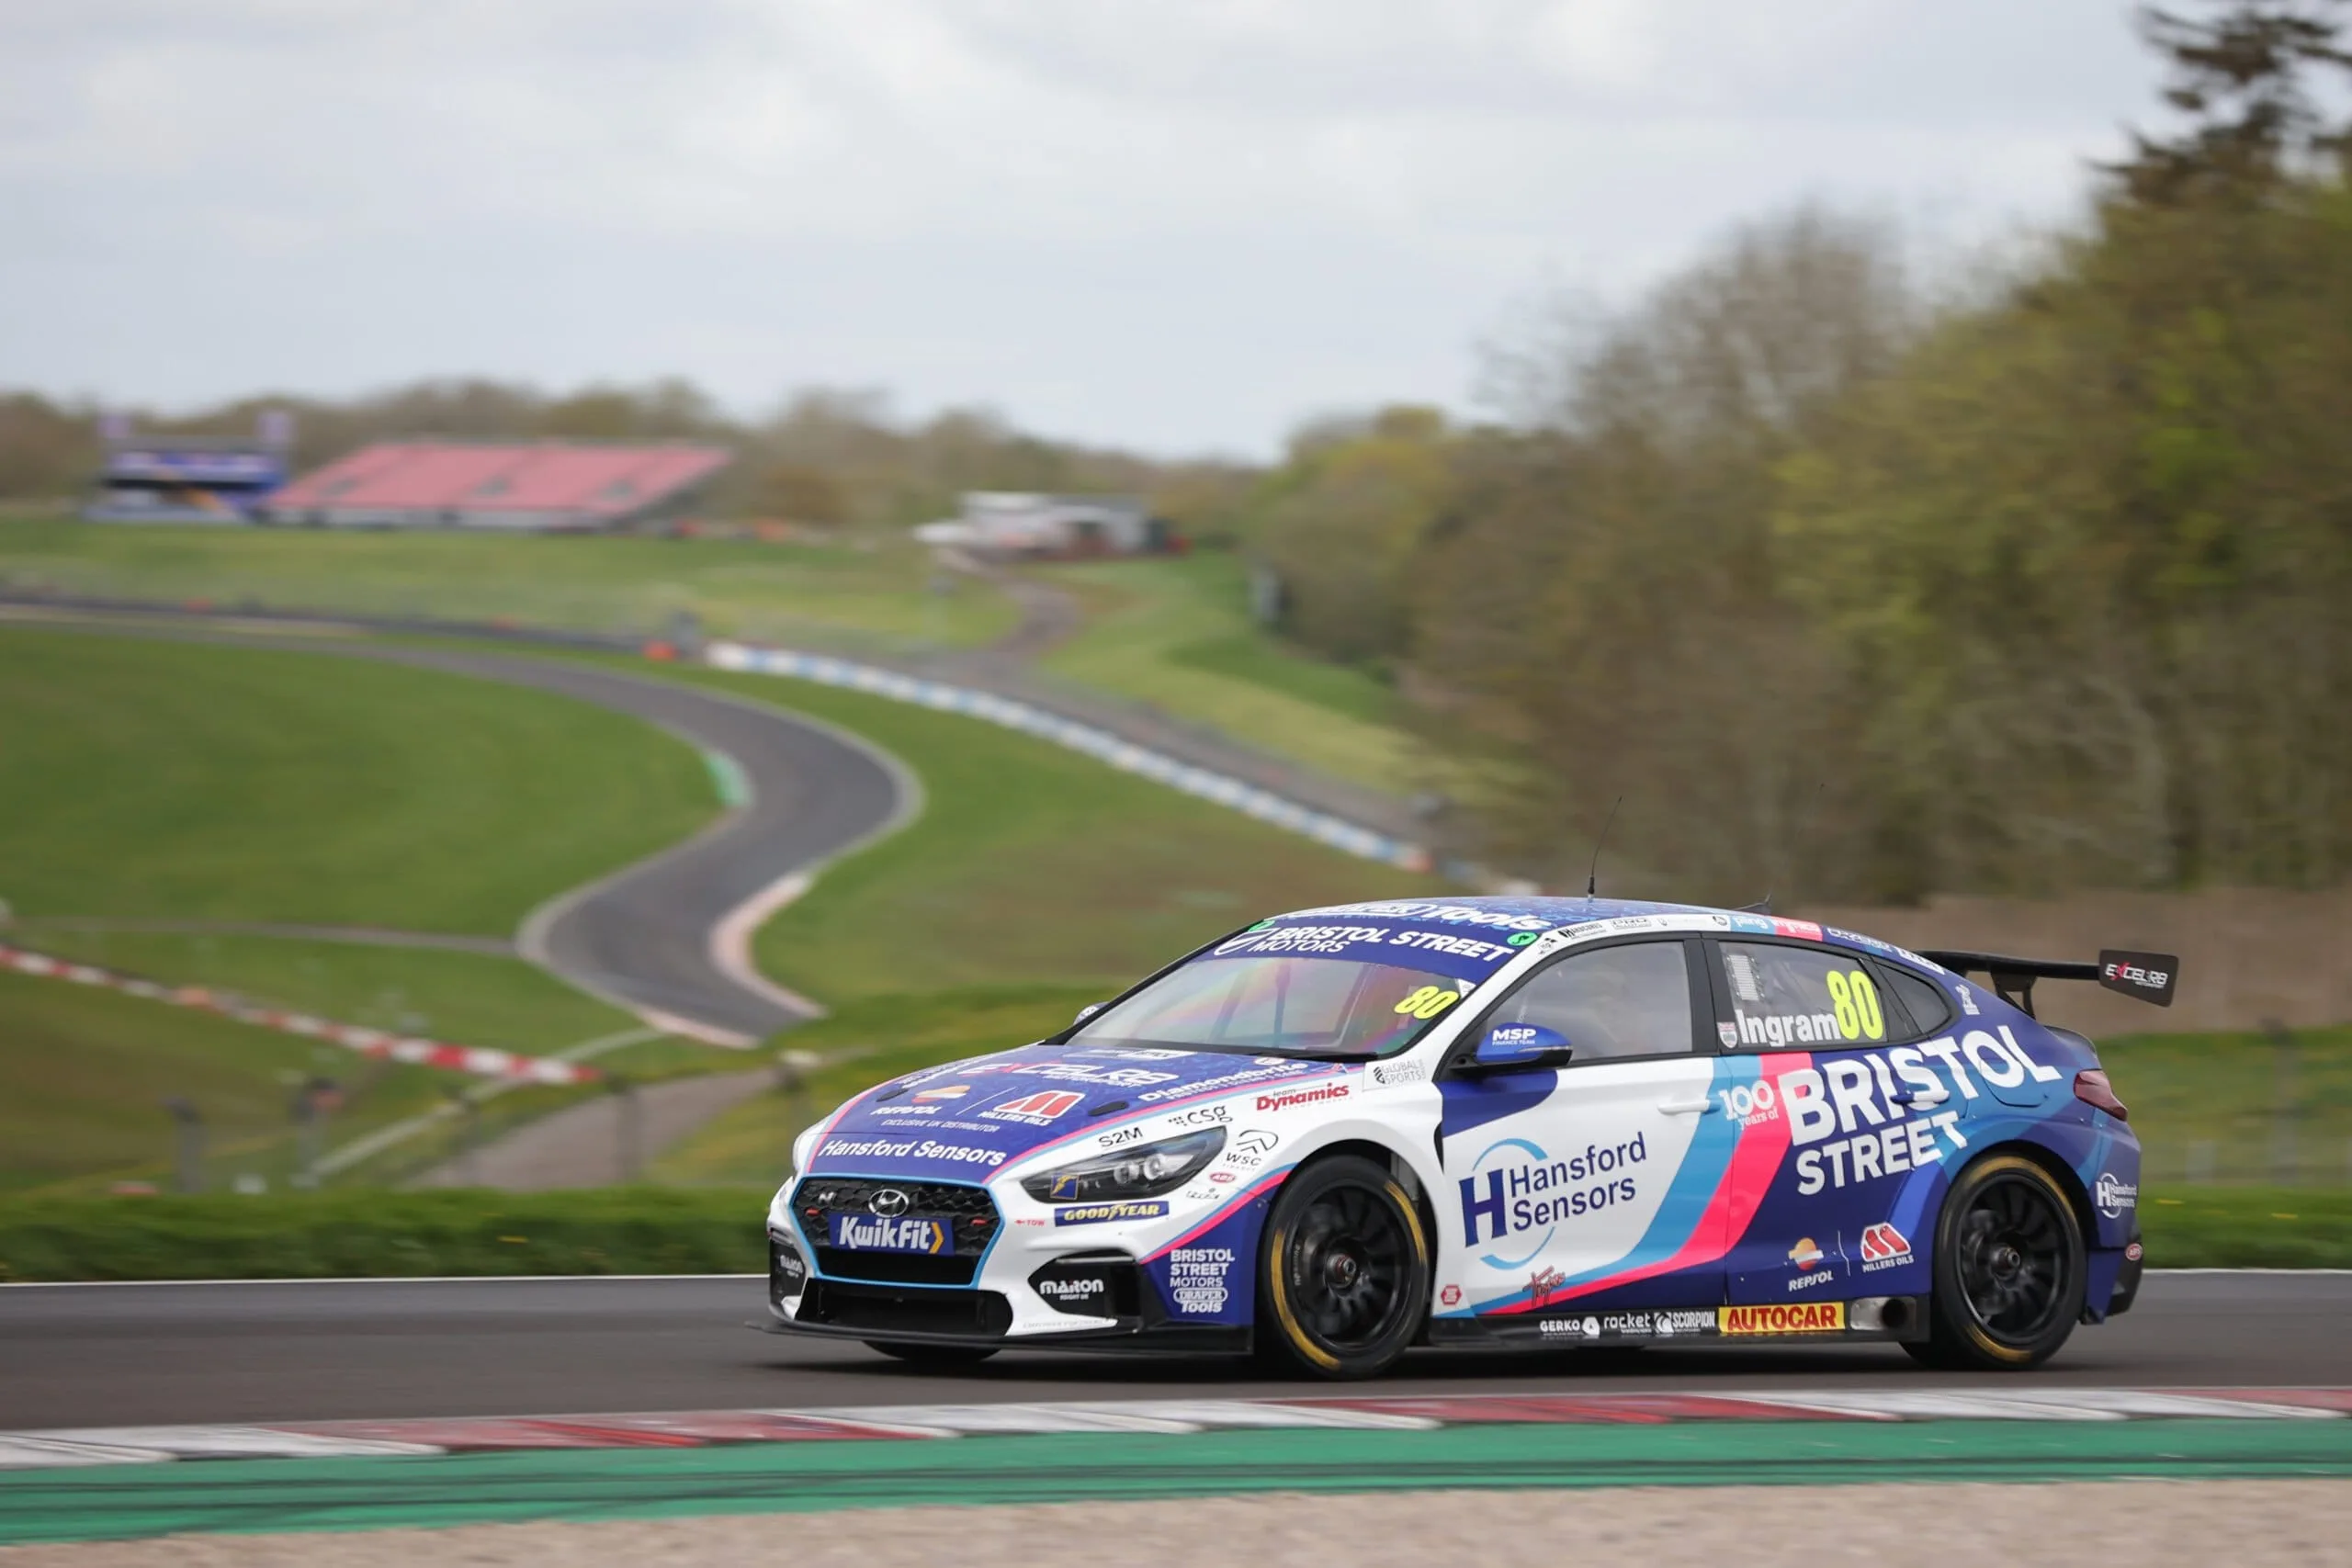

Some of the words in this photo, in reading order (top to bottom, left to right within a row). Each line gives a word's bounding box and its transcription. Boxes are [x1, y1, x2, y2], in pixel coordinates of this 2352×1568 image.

[1247, 940, 1351, 953] MOTORS
[1266, 926, 1390, 943] BRISTOL
[1388, 931, 1515, 962] STREET
[1394, 986, 1460, 1020] 80
[1826, 970, 1883, 1040] 80
[1492, 1028, 1537, 1041] MSP
[1734, 1009, 1842, 1047] Ingram
[1381, 1060, 1419, 1074] GLOBAL
[1385, 1070, 1422, 1084] SPORTS
[1256, 1083, 1350, 1111] Dynamics
[1778, 1025, 2063, 1146] BRISTOL
[1718, 1079, 1775, 1121] 100
[1098, 1127, 1143, 1147] S2M
[818, 1139, 918, 1157] Hansford
[912, 1140, 1007, 1167] Sensors
[1226, 1152, 1262, 1167] WSC
[1510, 1131, 1647, 1198] Hansford
[1796, 1111, 1968, 1195] STREET
[1064, 1202, 1160, 1221] GOODYEAR
[1459, 1168, 1508, 1248] H
[1512, 1177, 1636, 1232] Sensors
[1170, 1248, 1236, 1263] BRISTOL
[1862, 1258, 1896, 1273] MILLERS
[1896, 1254, 1915, 1266] OILS
[1170, 1263, 1230, 1276] STREET
[1170, 1277, 1224, 1287] MOTORS
[1788, 1269, 1834, 1292] REPSOL
[1182, 1300, 1223, 1313] Tools
[1540, 1319, 1580, 1332] GERKO
[1603, 1312, 1651, 1329] rocket
[1673, 1311, 1715, 1328] SCORPION
[1727, 1304, 1837, 1331] AUTOCAR
